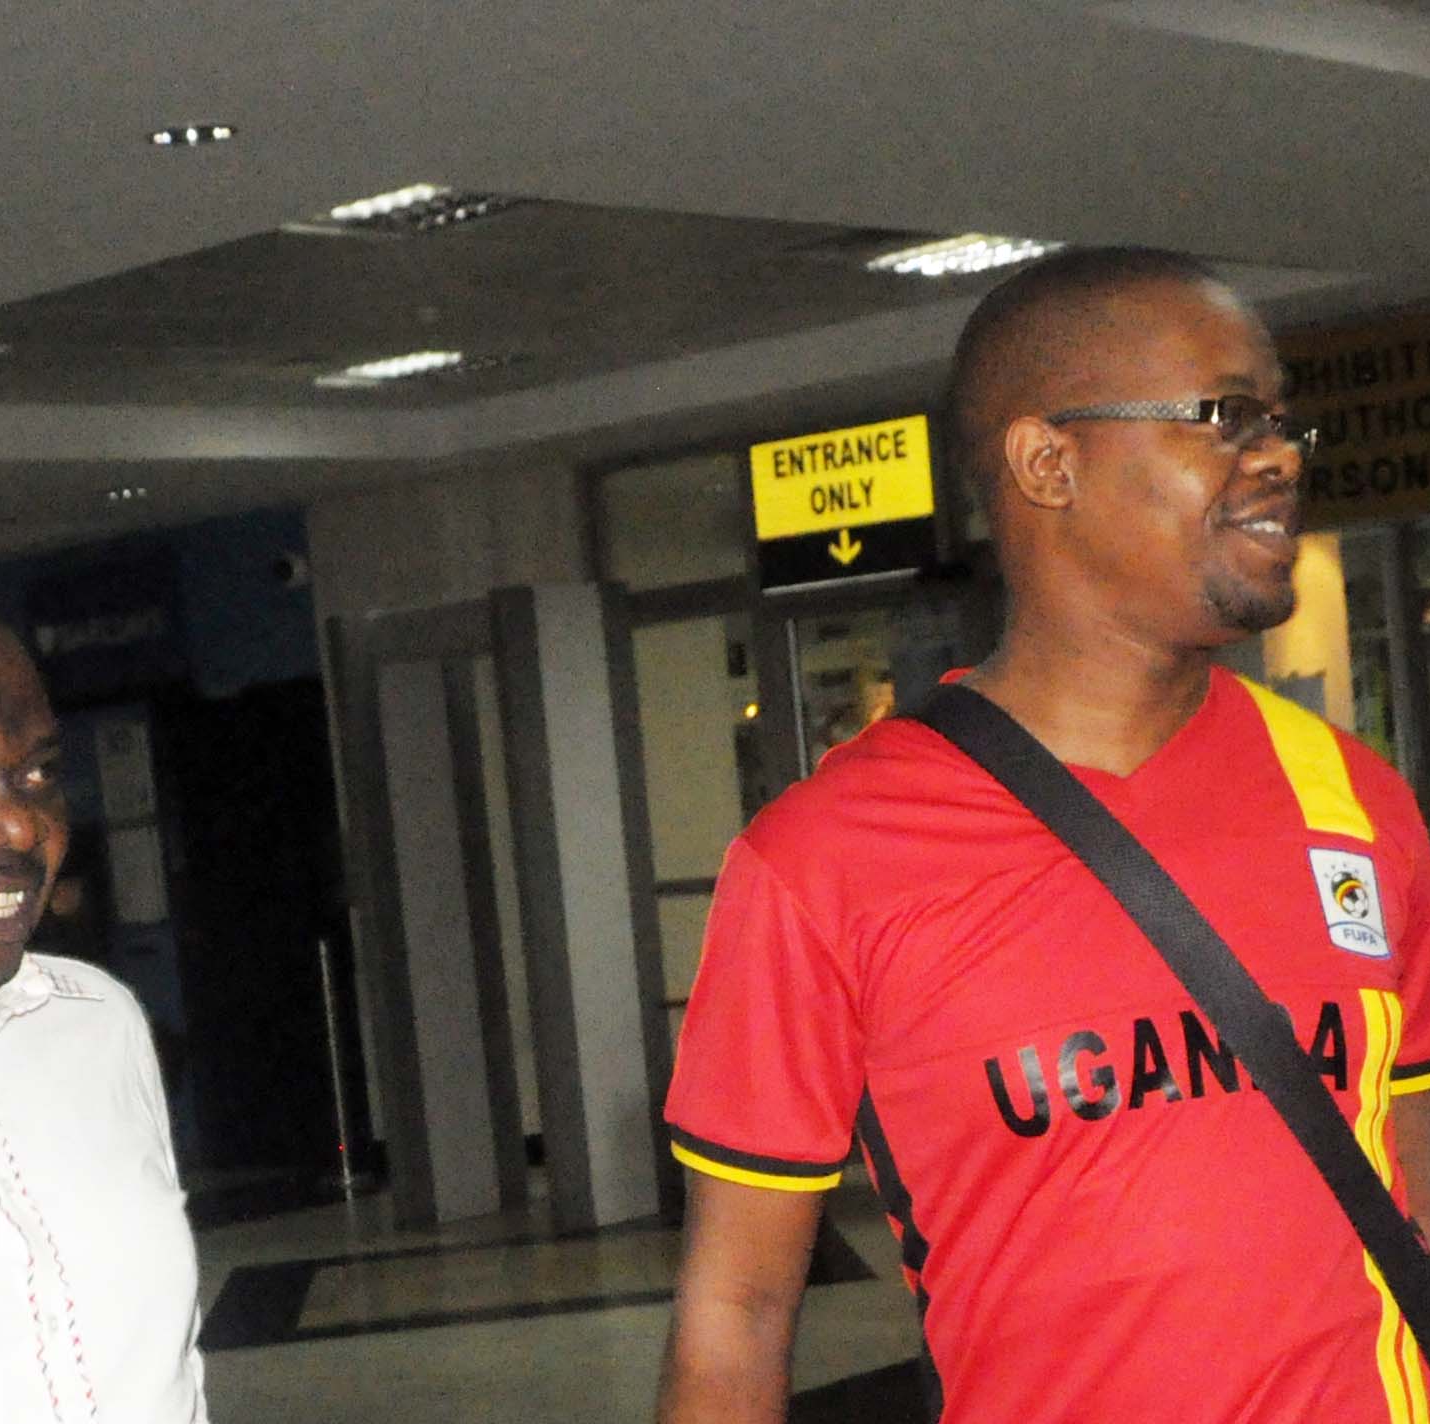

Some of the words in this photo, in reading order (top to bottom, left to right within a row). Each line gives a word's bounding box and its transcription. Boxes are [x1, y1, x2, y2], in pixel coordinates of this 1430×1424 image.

[773, 429, 908, 478] ENTRANCE
[810, 477, 874, 515] ONLY
[1342, 927, 1378, 946] FUFA
[982, 1001, 1348, 1138] UGANA
